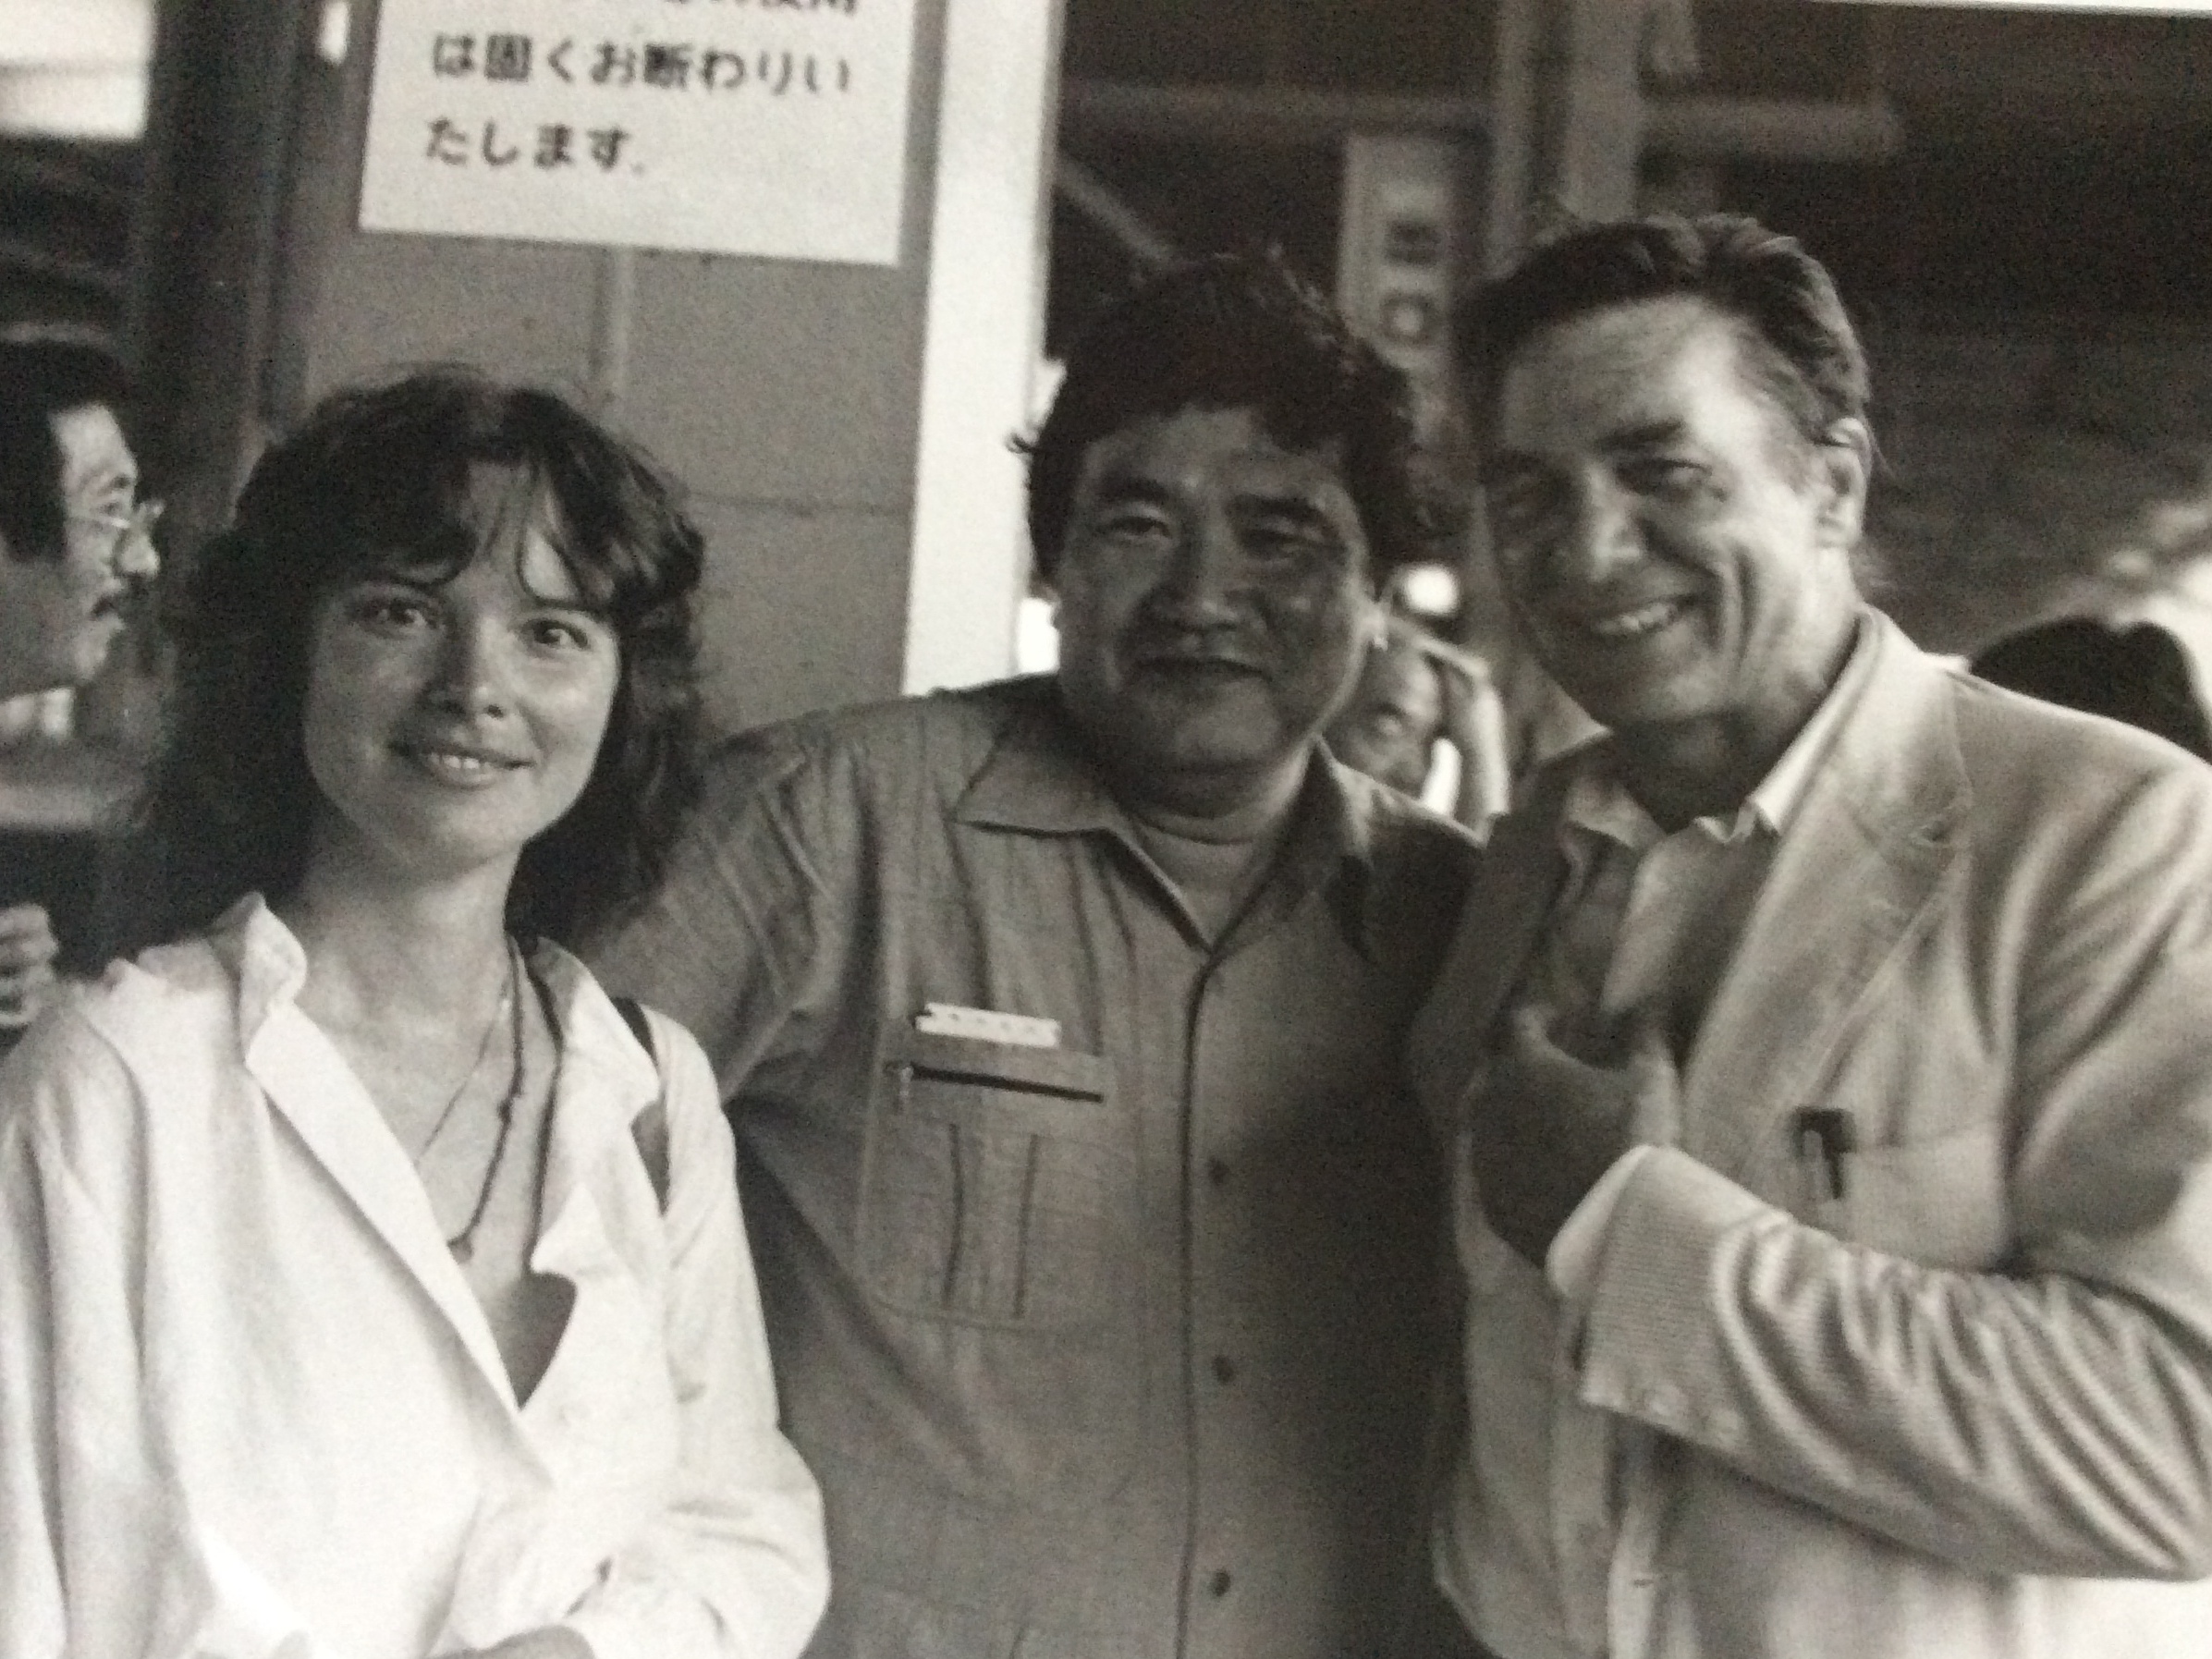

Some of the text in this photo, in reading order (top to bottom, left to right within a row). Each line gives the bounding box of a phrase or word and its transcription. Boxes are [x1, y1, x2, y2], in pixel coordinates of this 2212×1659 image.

[433, 31, 850, 95] は固くお断わりい
